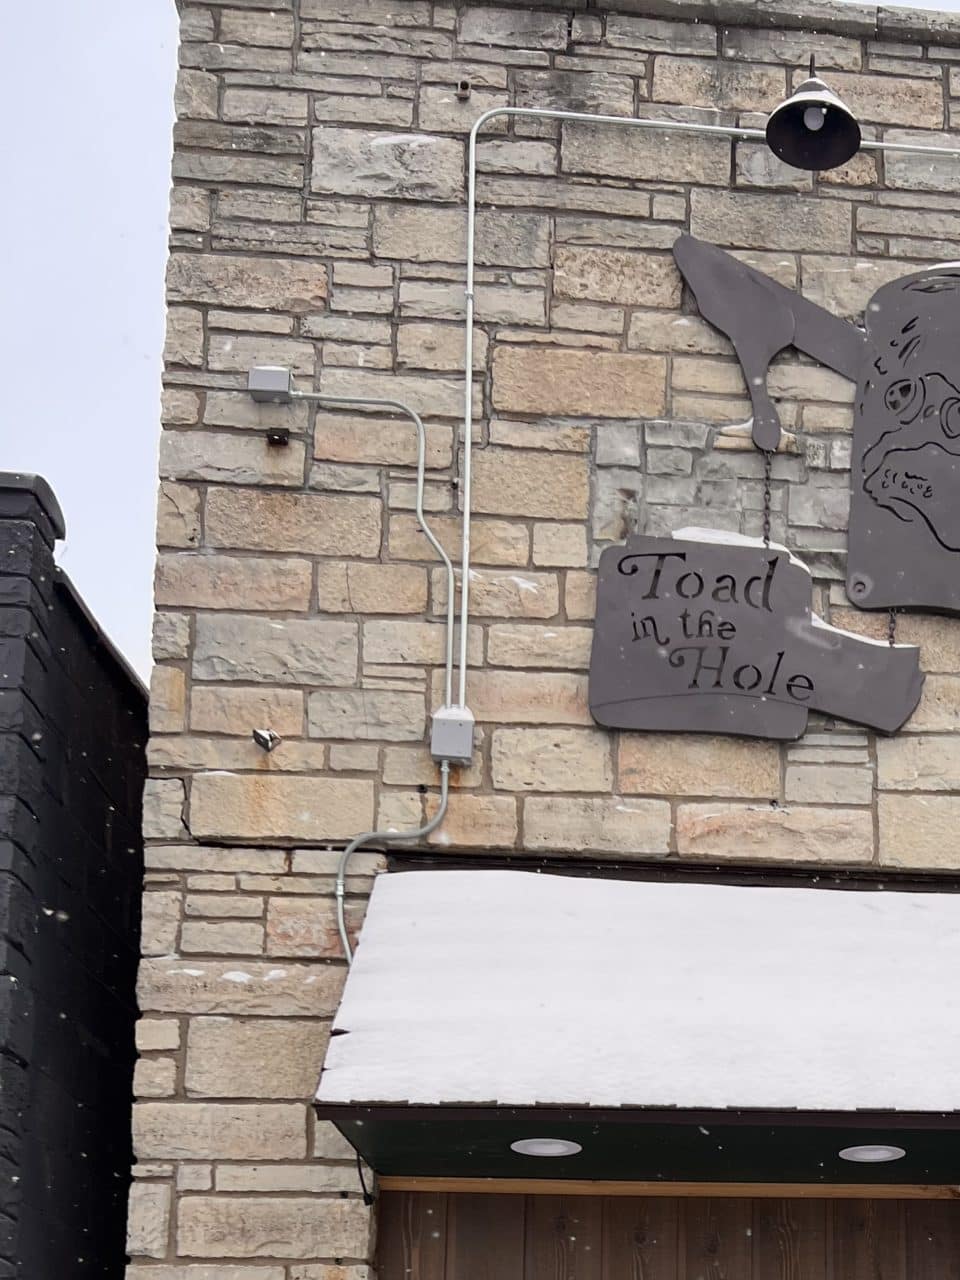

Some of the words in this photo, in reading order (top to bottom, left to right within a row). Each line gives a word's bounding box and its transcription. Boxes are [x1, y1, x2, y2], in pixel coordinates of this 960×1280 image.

[617, 552, 779, 612] Toad
[631, 612, 670, 646] in
[678, 608, 738, 641] the
[668, 646, 815, 700] Hole
